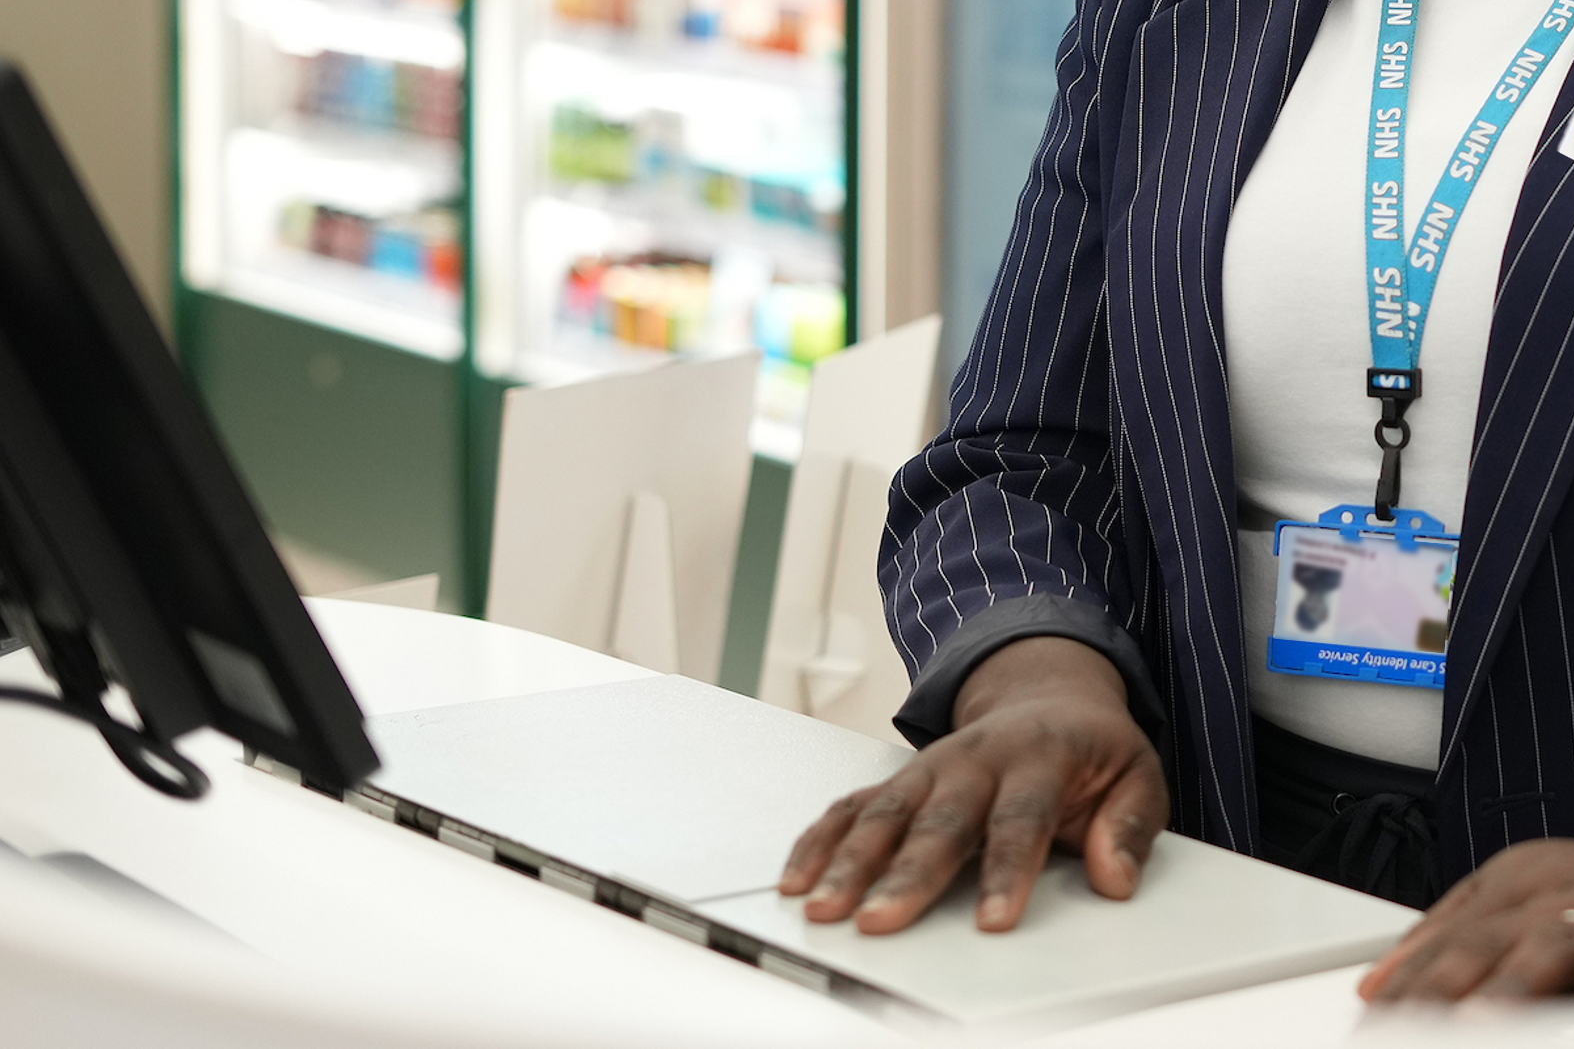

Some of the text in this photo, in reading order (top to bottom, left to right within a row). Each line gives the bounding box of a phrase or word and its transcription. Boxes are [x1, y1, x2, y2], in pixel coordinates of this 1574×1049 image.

[1380, 40, 1408, 89] NHS
[1496, 47, 1546, 104] NHS
[1374, 106, 1402, 159] NHS
[1450, 120, 1499, 183] NHS
[1372, 180, 1399, 240] NHS
[1410, 201, 1456, 273] NHS
[1373, 267, 1404, 339] NHS
[1318, 649, 1360, 666] Service
[1361, 651, 1408, 670] Identity
[1409, 659, 1437, 673] Care
